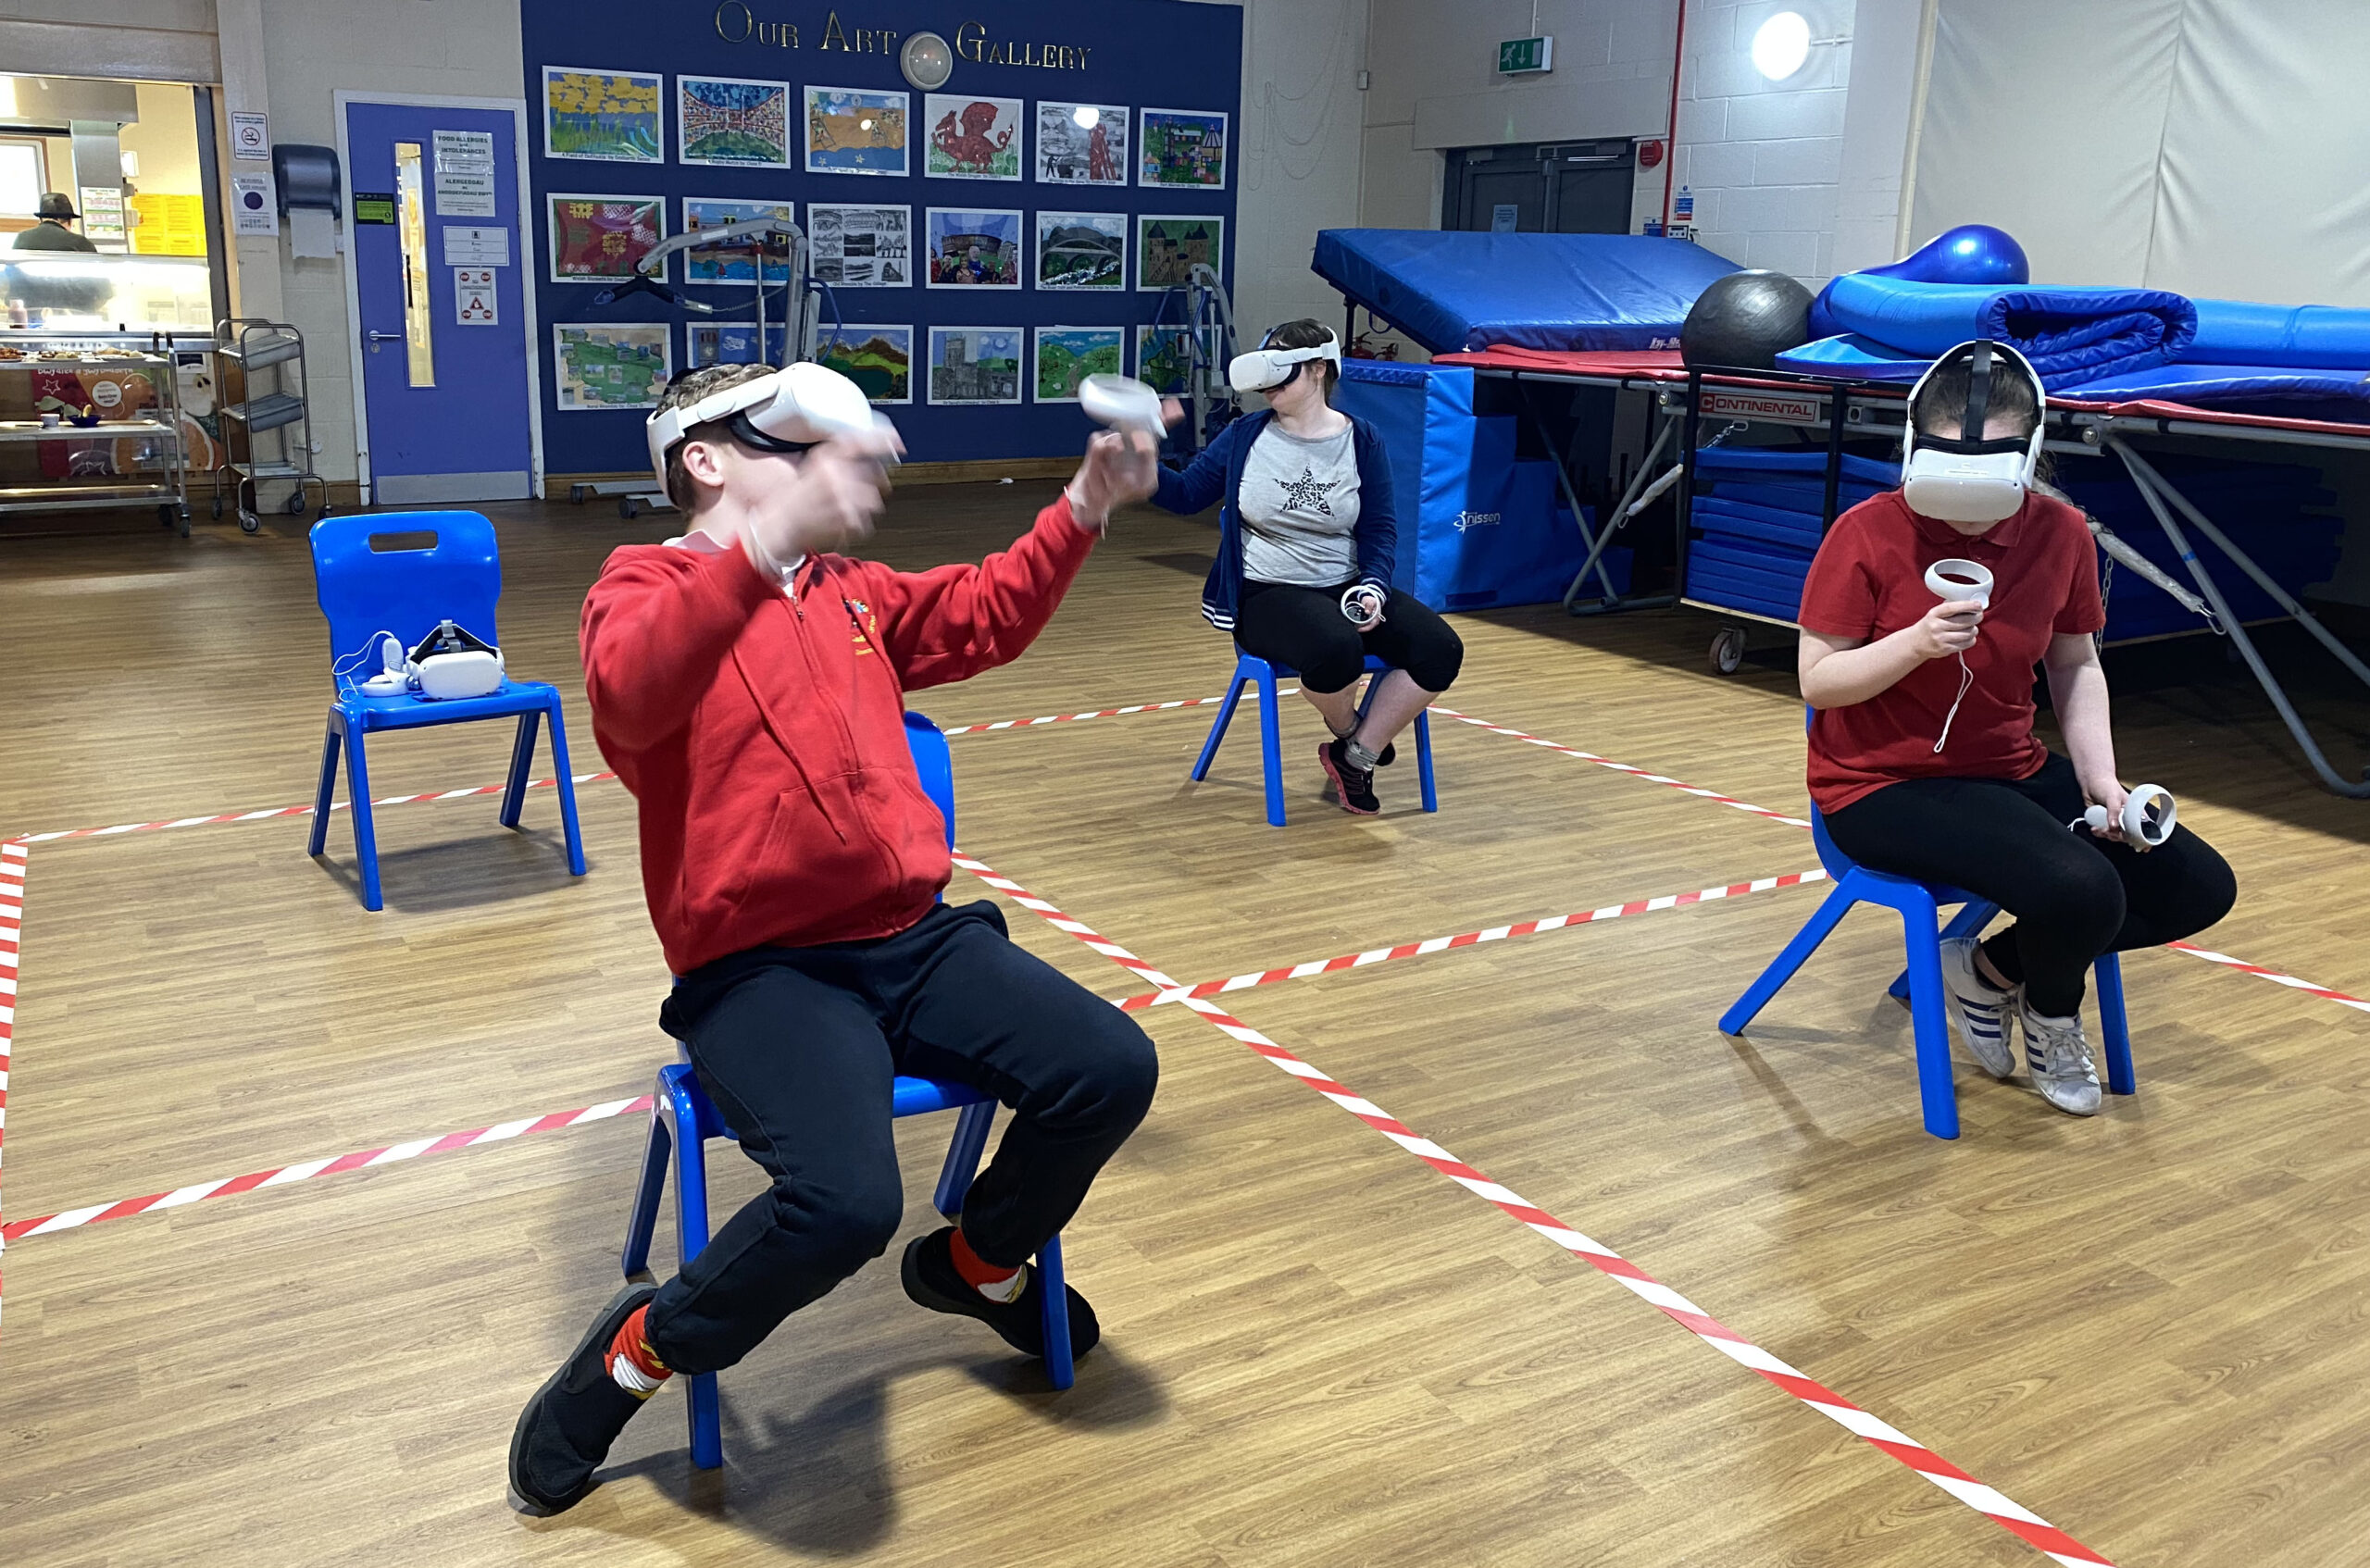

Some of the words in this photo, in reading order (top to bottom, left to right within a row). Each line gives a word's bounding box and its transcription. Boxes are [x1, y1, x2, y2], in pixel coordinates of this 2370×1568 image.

[819, 9, 897, 56] ART
[955, 20, 1092, 70] GALLERY
[1702, 395, 1813, 416] CONTINENTAL
[1467, 512, 1501, 524] nissen
